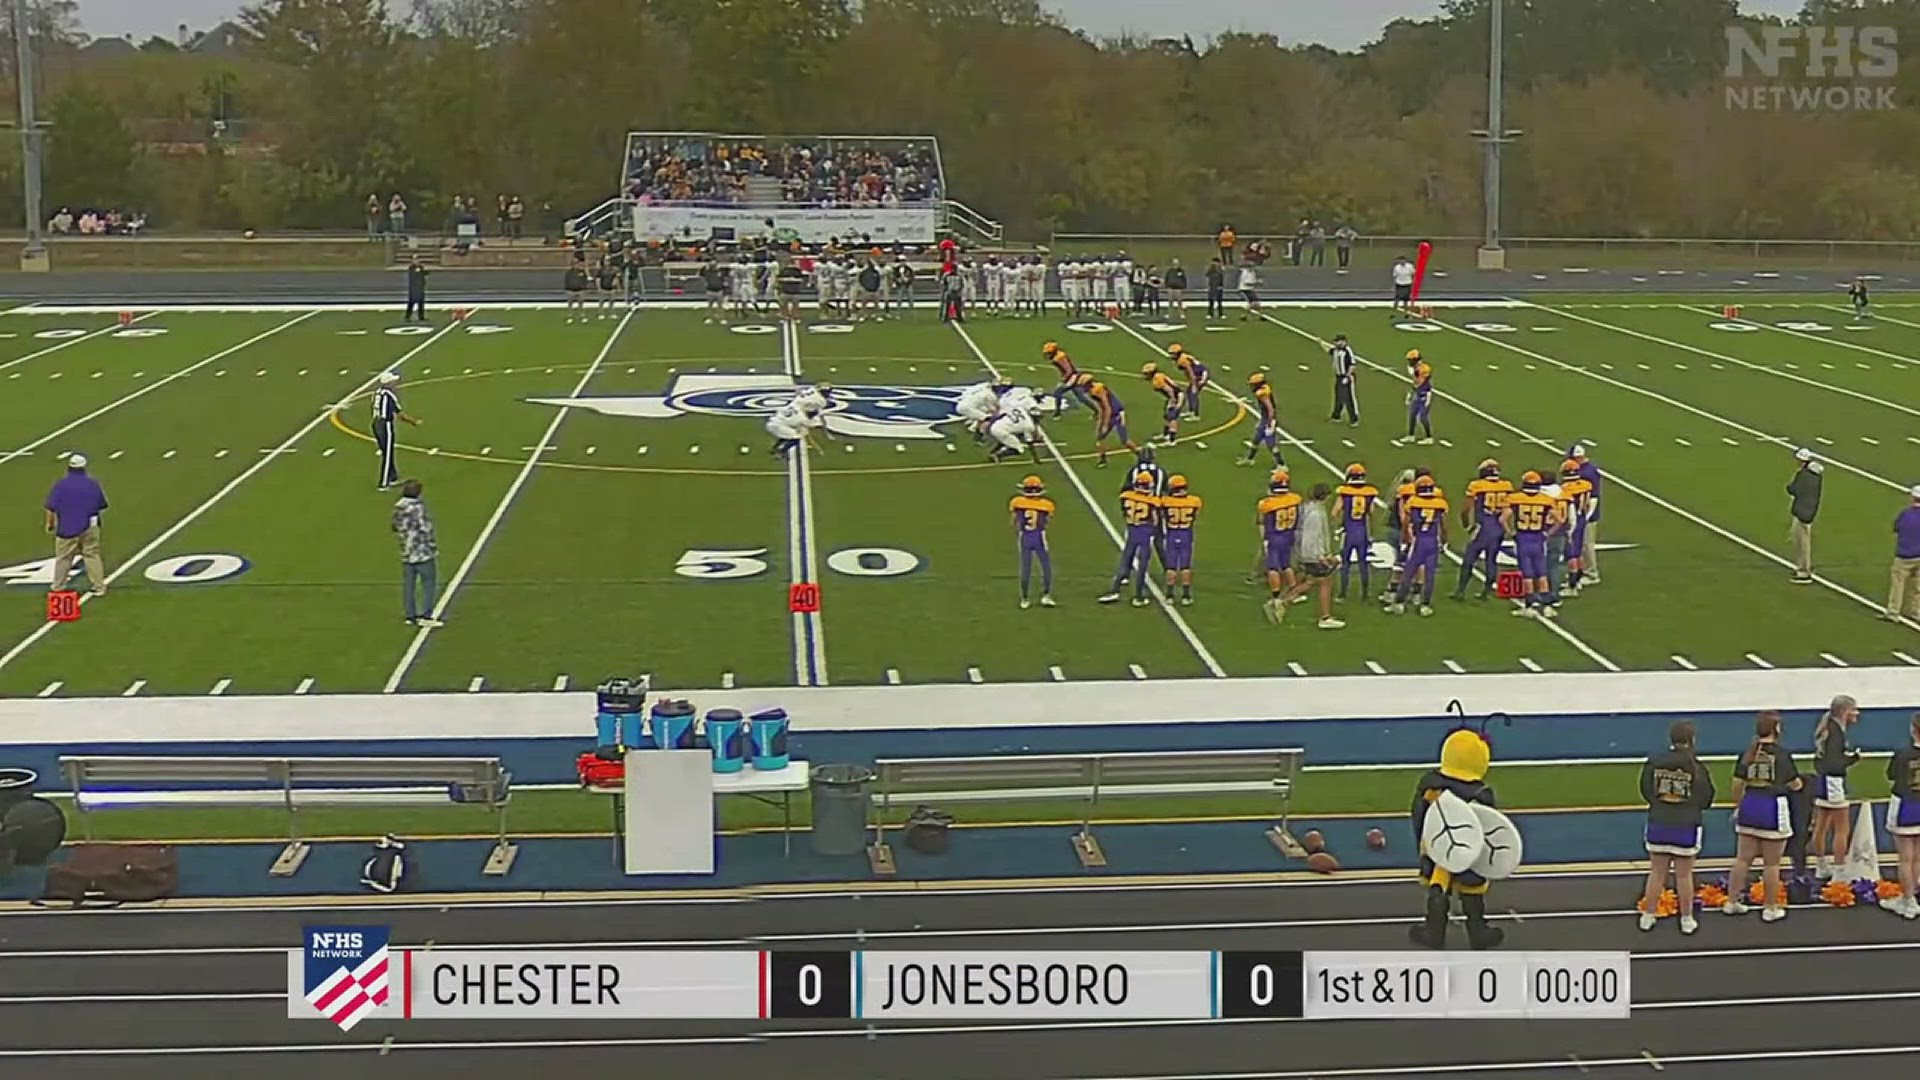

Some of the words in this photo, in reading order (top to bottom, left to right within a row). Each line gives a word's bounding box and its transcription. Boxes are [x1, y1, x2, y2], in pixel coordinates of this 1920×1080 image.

[1024, 509, 1038, 531] 3
[1123, 499, 1149, 526] 32
[1420, 508, 1434, 531] 7
[1517, 504, 1545, 531] 55
[1501, 574, 1524, 595] 30
[50, 594, 74, 617] 30
[791, 586, 816, 608] 40
